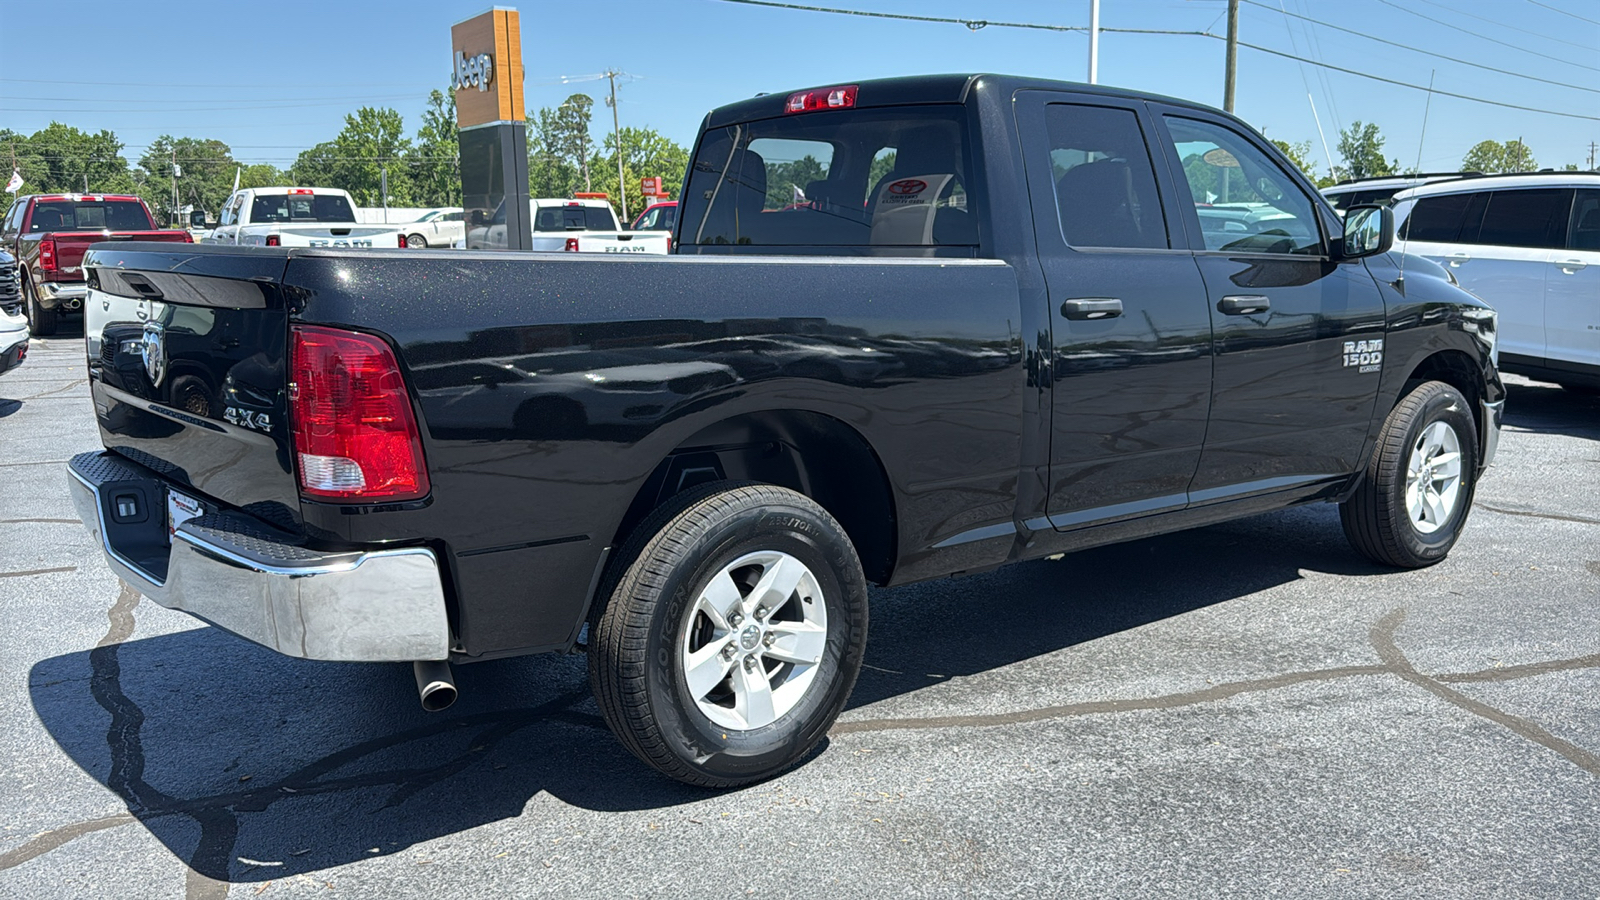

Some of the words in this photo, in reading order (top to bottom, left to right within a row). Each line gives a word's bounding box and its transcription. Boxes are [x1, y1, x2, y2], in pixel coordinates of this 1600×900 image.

[451, 51, 492, 92] Jeep
[308, 239, 373, 249] RAM
[1343, 339, 1383, 353] RAM
[1342, 352, 1382, 366] 1500
